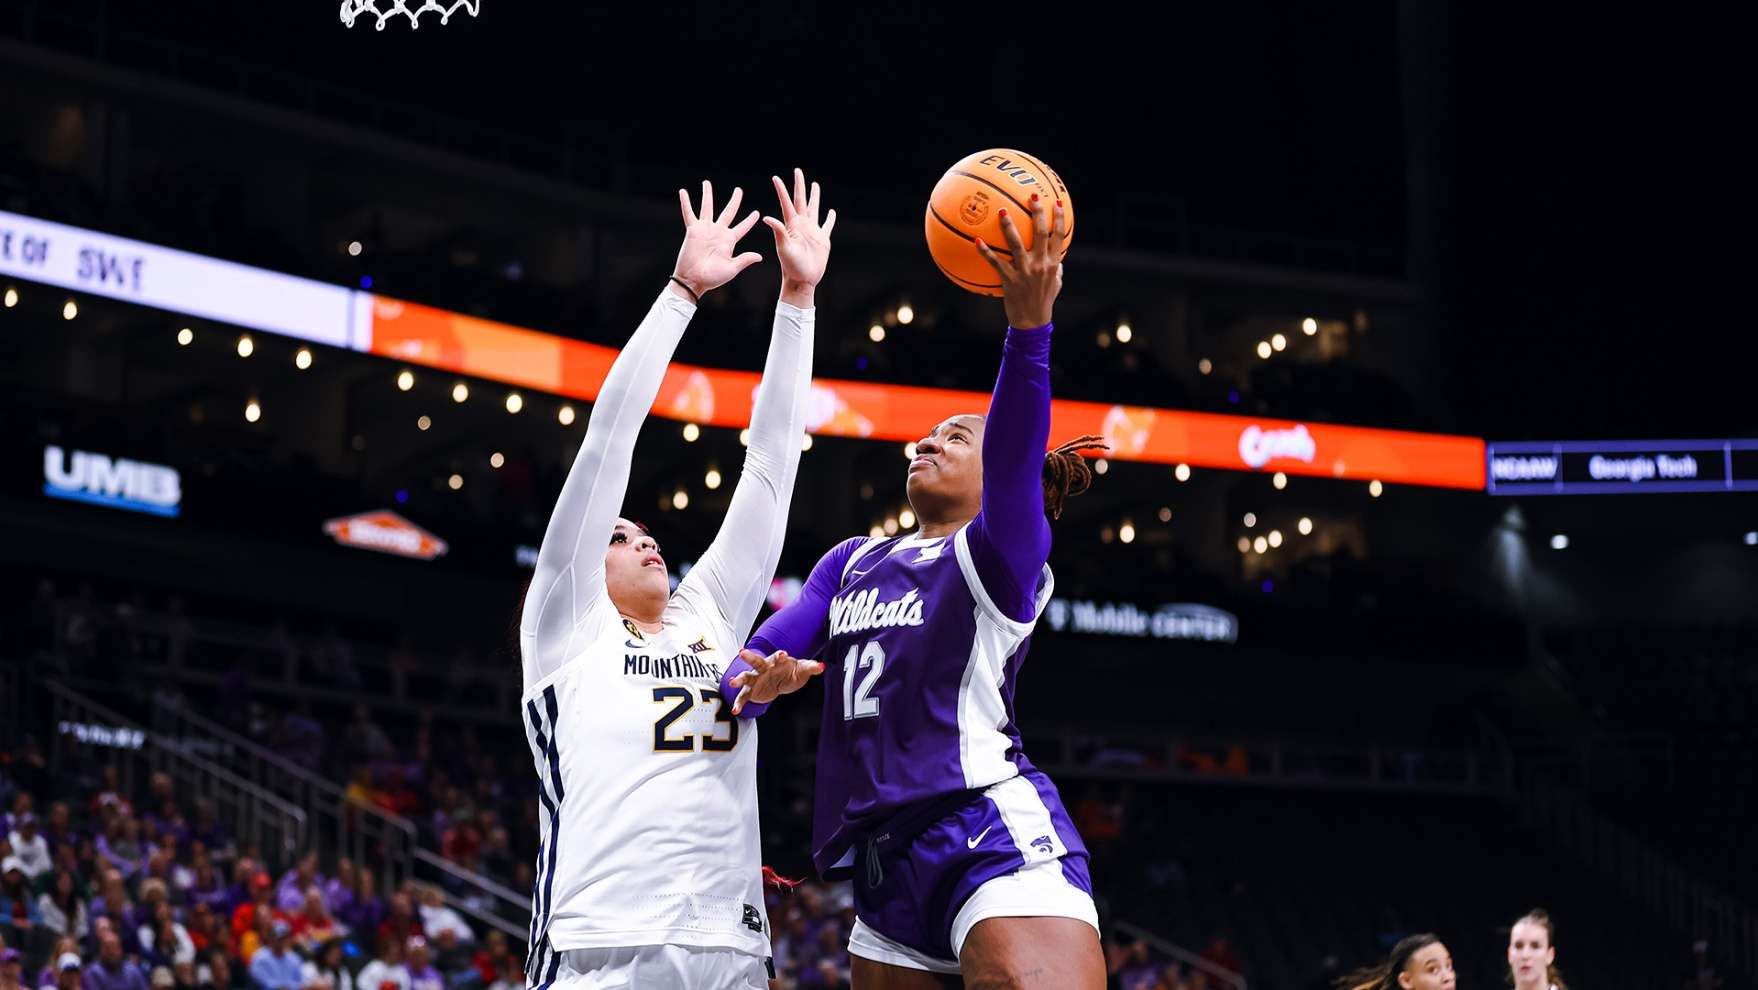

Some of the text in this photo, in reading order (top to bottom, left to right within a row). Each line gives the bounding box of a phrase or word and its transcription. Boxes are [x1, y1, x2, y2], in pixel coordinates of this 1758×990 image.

[44, 444, 181, 507] UMB
[1589, 453, 1698, 483] Georgia Tech
[828, 587, 925, 640] Wildcats
[843, 640, 886, 721] 12
[652, 685, 739, 752] 23
